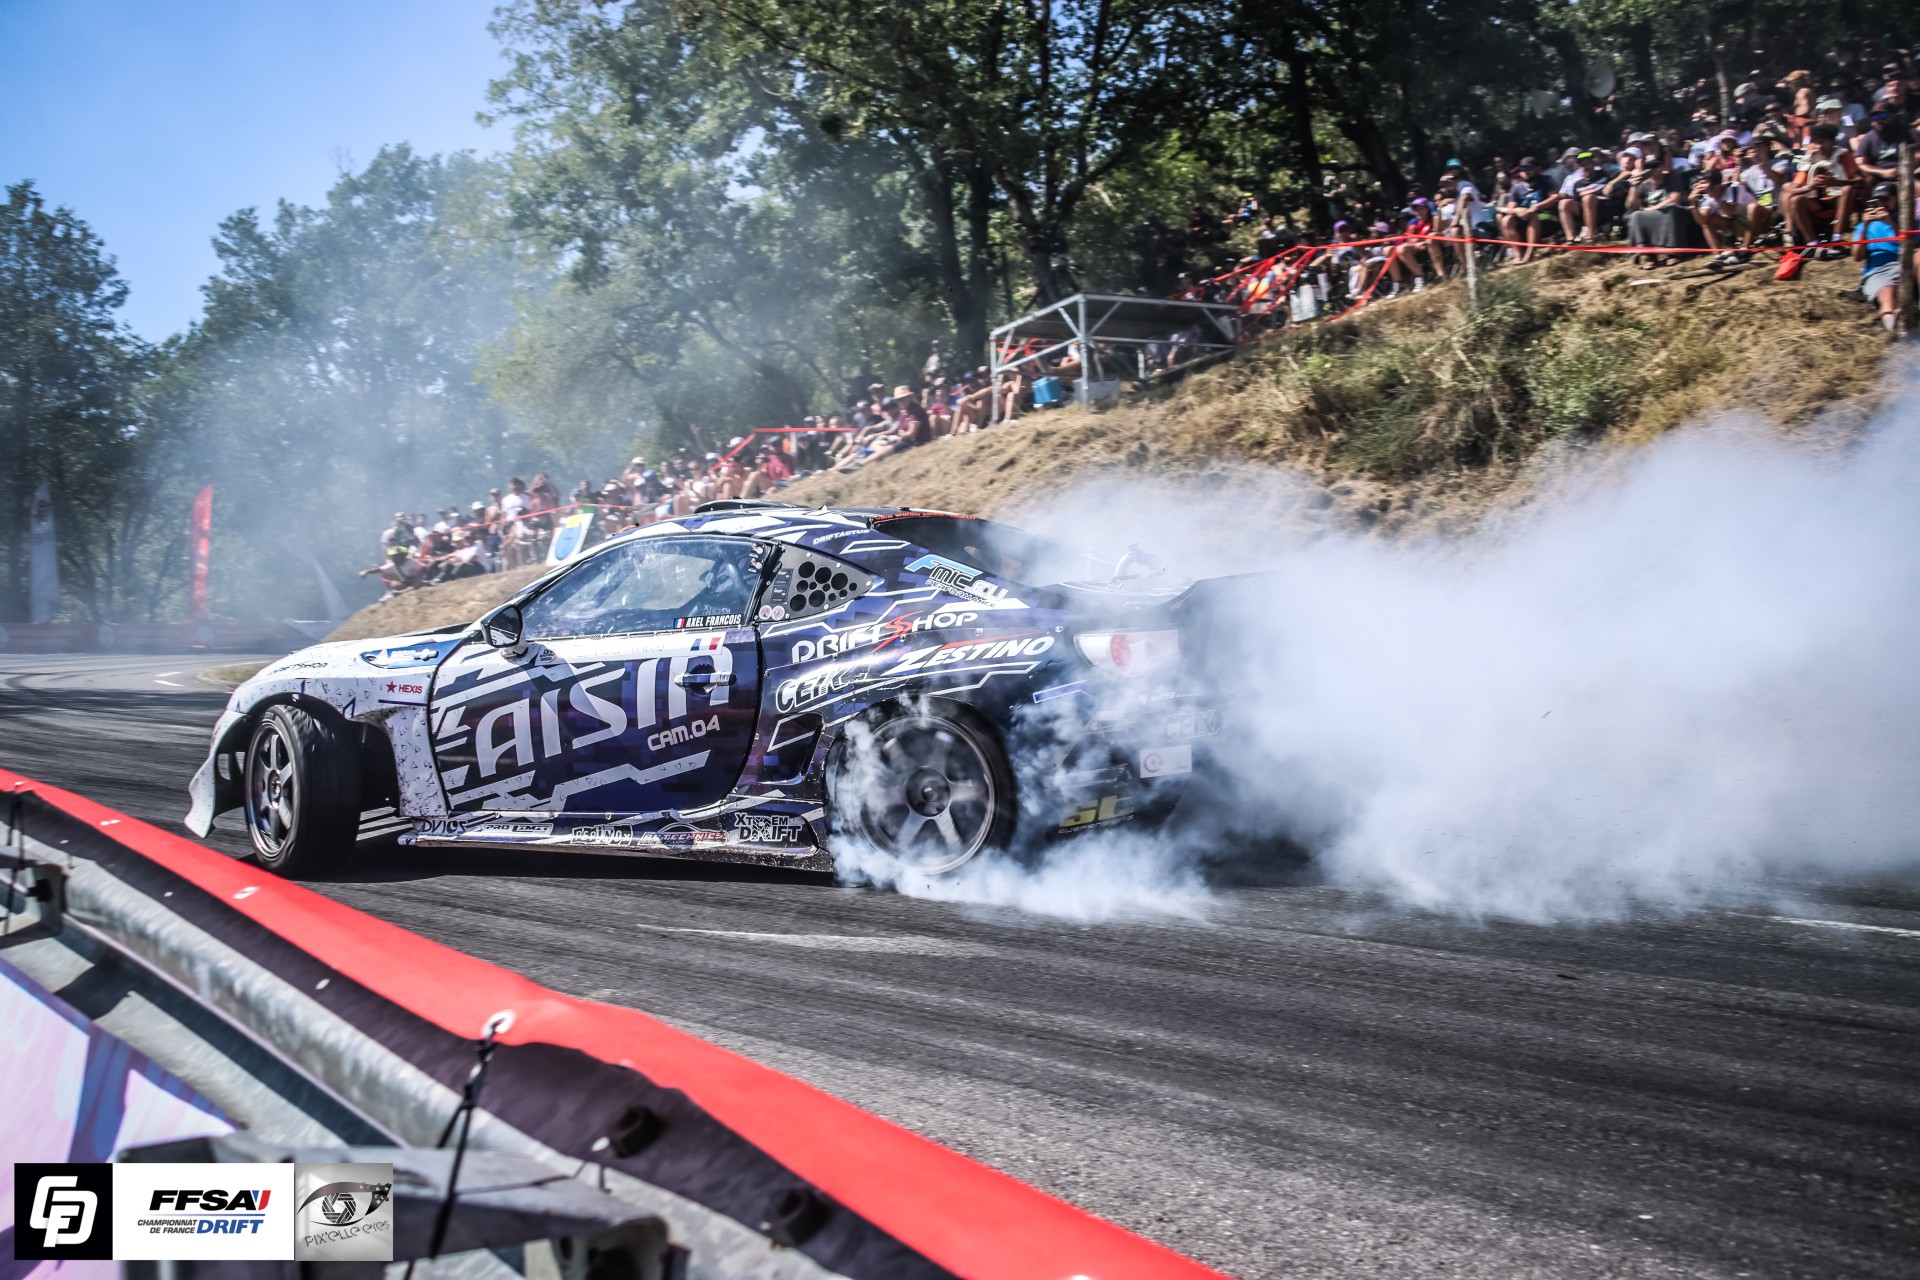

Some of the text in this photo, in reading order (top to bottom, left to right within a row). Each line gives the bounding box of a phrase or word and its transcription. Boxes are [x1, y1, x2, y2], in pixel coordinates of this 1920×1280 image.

[686, 614, 742, 627] AXEL FRANCOIS
[880, 636, 1055, 676] ZESTINO
[398, 685, 423, 694] HEXIS
[647, 715, 721, 752] CAM.04
